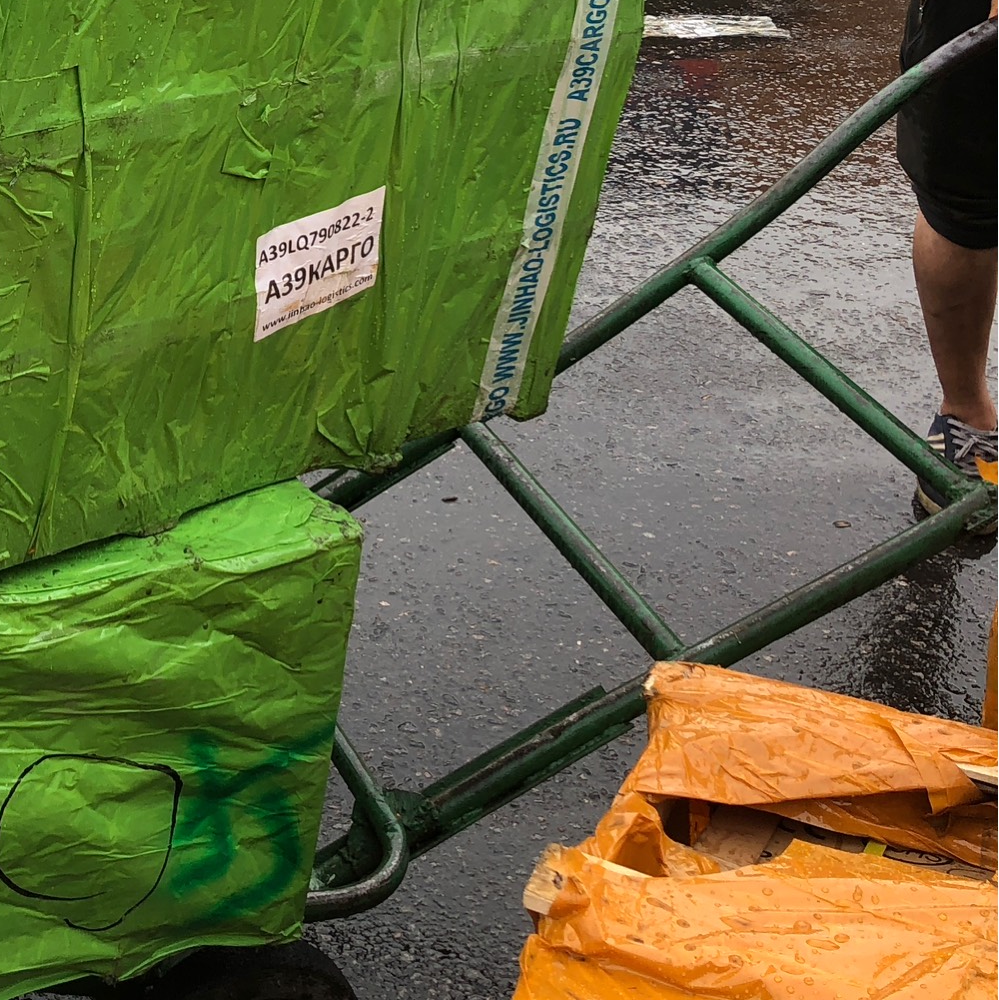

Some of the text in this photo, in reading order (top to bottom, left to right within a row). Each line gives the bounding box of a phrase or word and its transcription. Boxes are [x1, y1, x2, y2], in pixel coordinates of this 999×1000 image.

[259, 206, 374, 266] A39LQ790822-2
[500, 117, 581, 380] WWW.JINHAO-LOGISTICS.RU
[261, 272, 373, 332] www.jinhao-logistics.com
